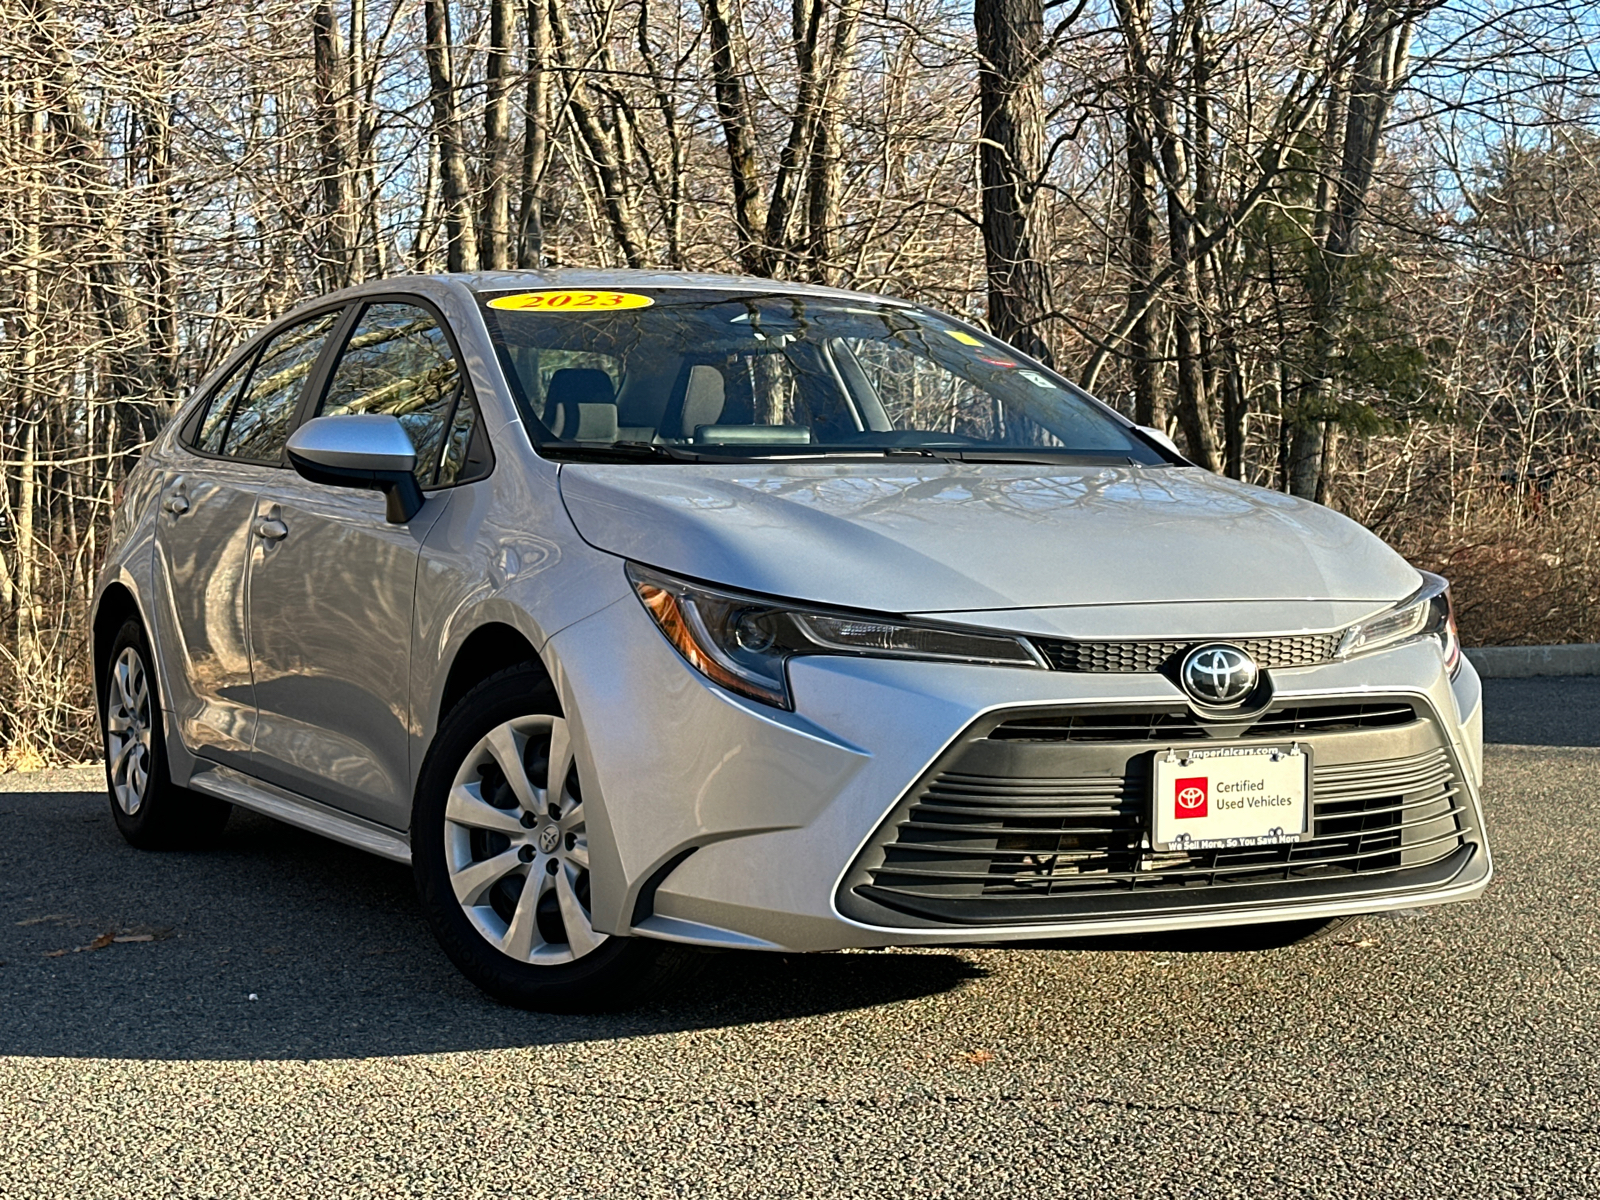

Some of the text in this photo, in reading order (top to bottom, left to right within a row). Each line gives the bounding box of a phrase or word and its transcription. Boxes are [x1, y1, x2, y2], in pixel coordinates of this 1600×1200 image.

[519, 294, 625, 308] 2023
[1188, 747, 1279, 760] Imperialcars.com
[1216, 779, 1264, 793] Certified
[1216, 795, 1292, 810] Used Vehicles
[1168, 833, 1300, 851] We Sell More, So You Save More
